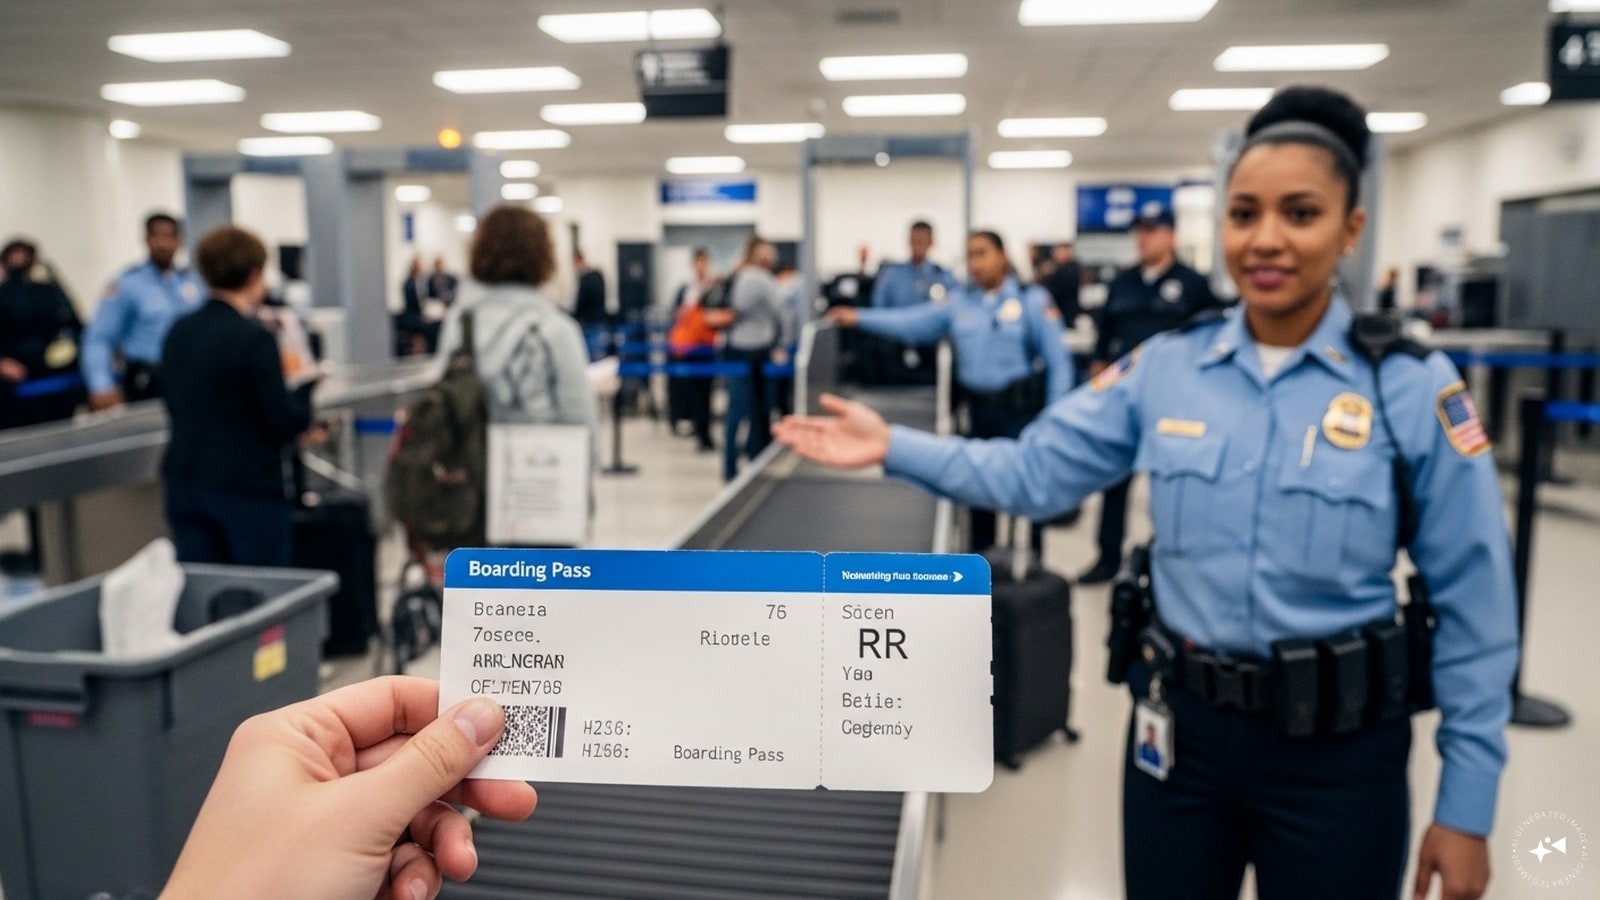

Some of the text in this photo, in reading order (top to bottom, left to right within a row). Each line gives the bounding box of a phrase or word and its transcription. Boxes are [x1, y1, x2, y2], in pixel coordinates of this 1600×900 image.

[468, 560, 591, 582] Boarding Pass
[766, 604, 787, 620] 76
[859, 627, 908, 660] RR
[673, 744, 785, 764] Boarding Pass
